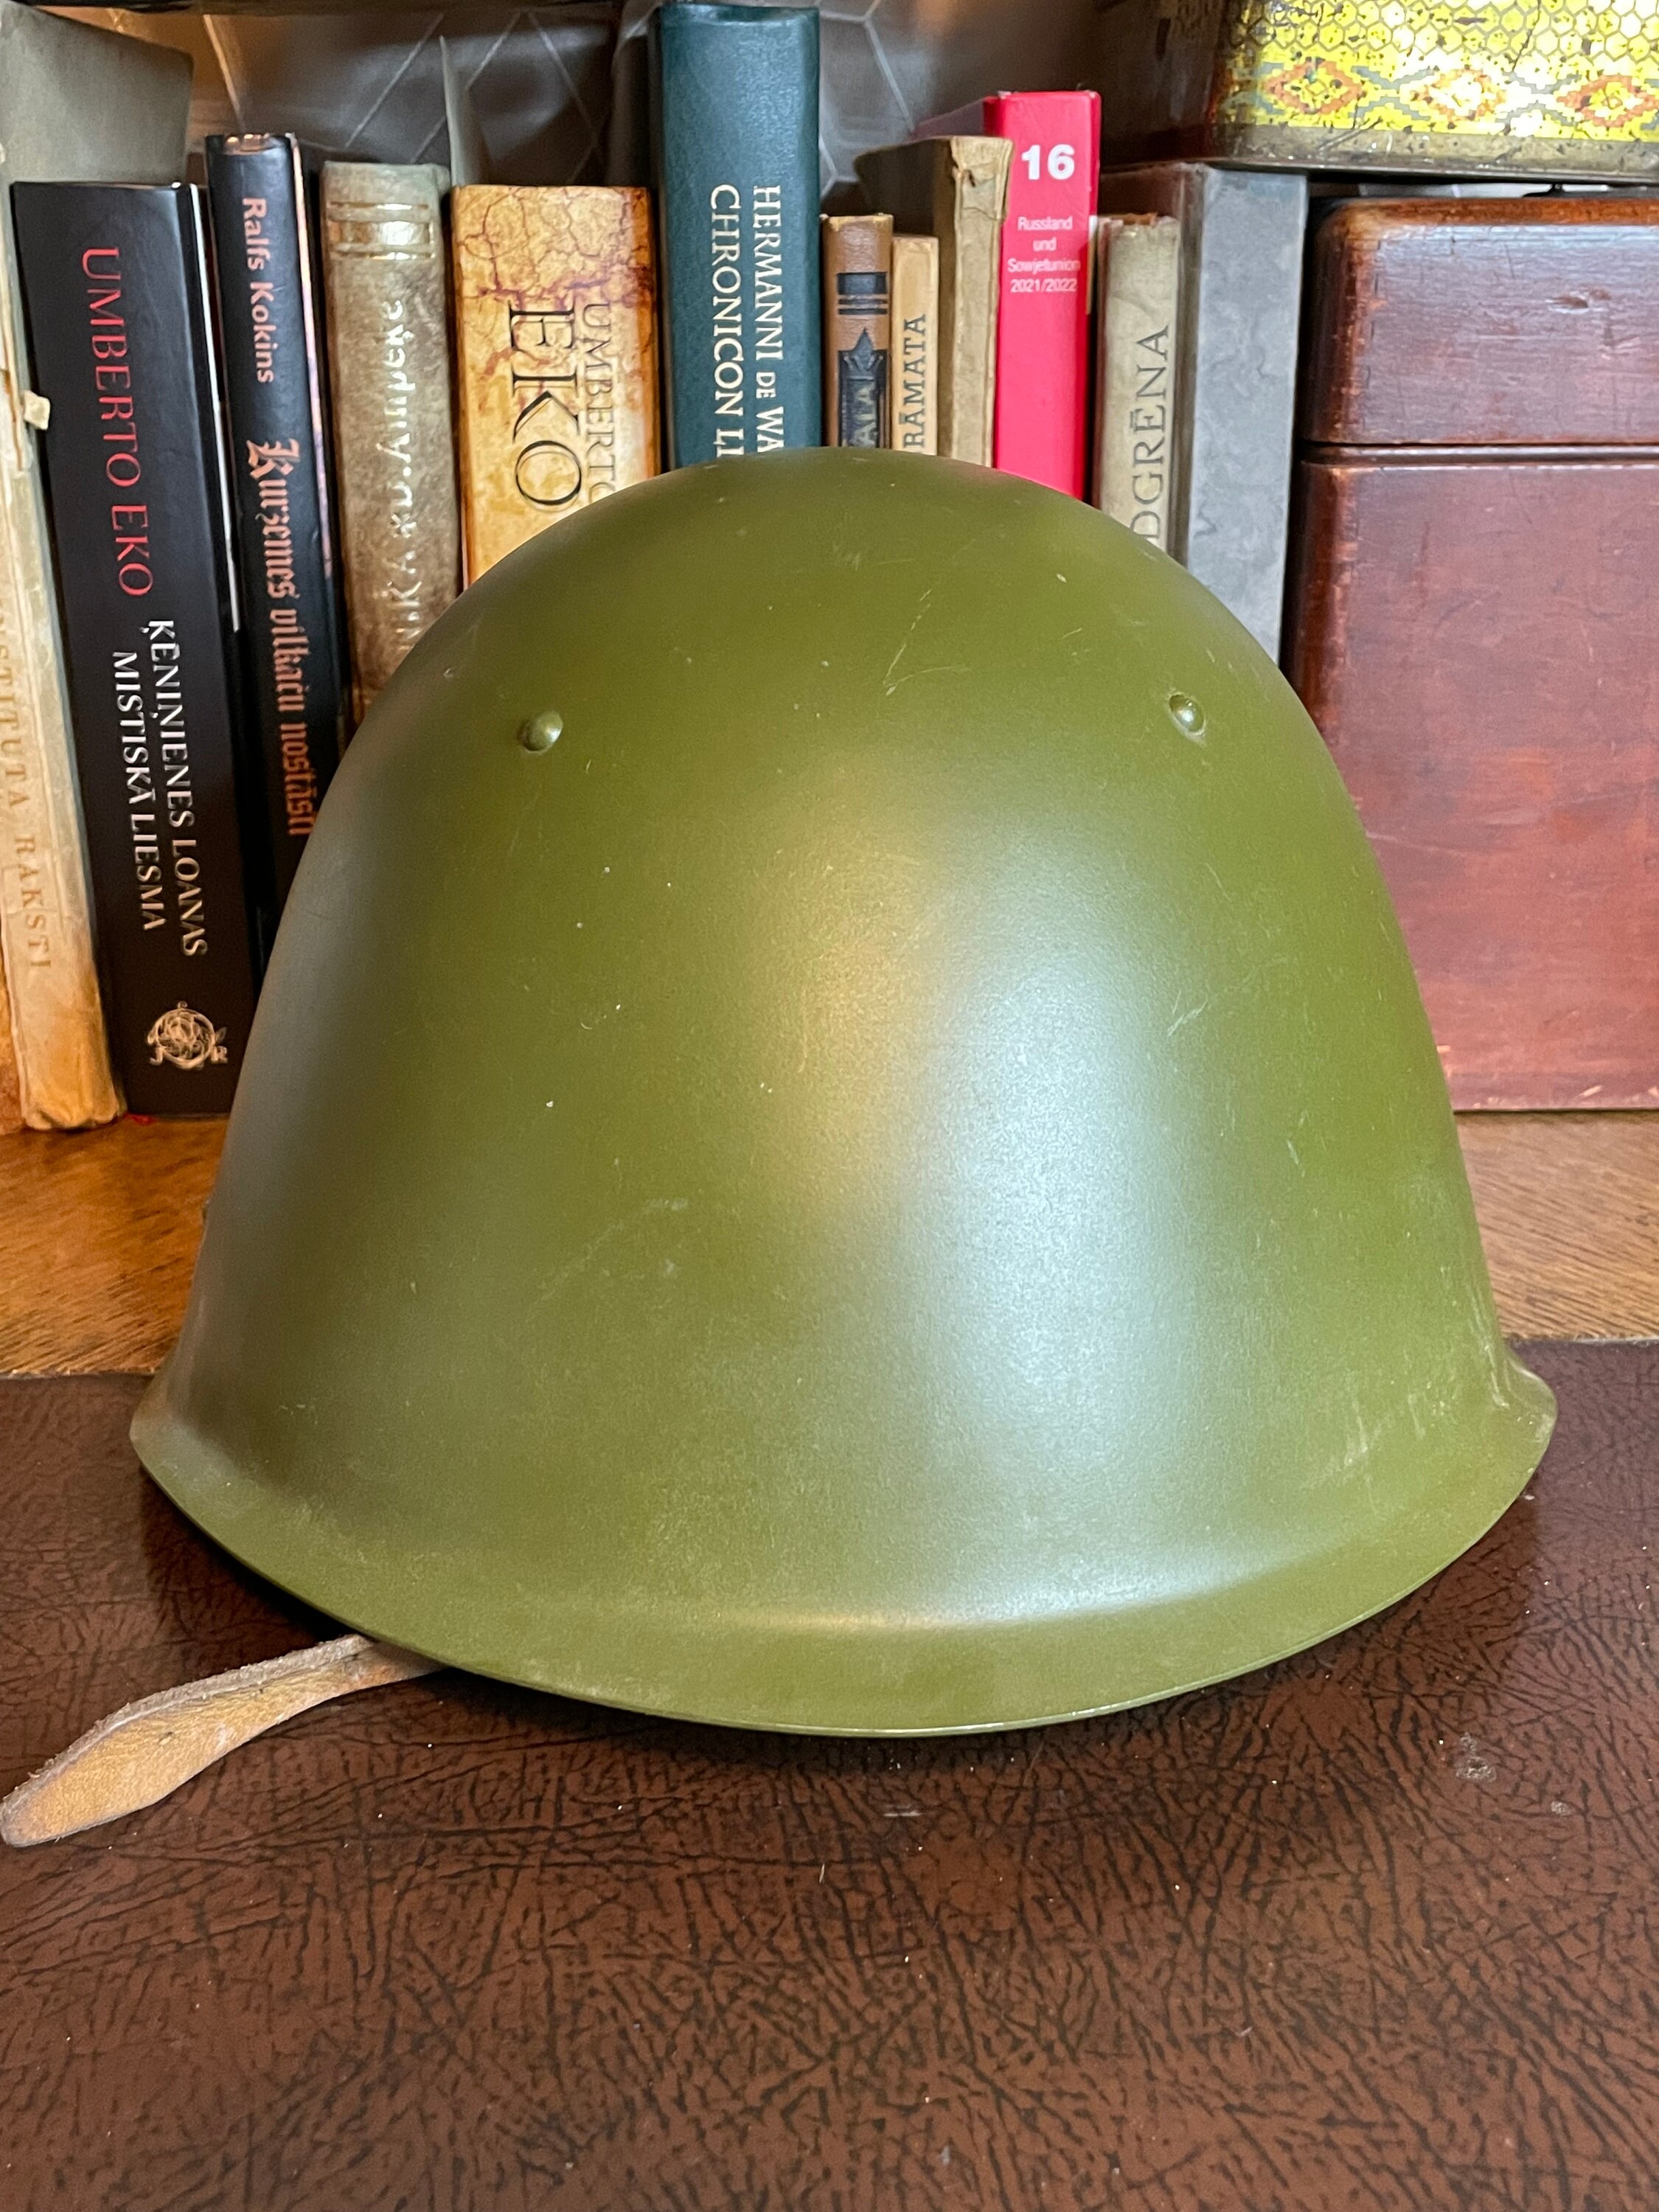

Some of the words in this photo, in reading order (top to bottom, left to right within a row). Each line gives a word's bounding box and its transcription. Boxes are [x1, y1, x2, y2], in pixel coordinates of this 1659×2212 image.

[1021, 144, 1075, 180] 16
[242, 197, 271, 271] Ralfs
[753, 185, 783, 360] HERMANNI
[1007, 257, 1080, 274] Sowjetunion
[1018, 215, 1073, 230] Russland
[1032, 237, 1057, 251] und
[250, 282, 278, 383] Kokins
[710, 184, 745, 417] CHRONICON
[1010, 278, 1078, 293] 2021/2022
[82, 247, 141, 487] UMBERTO
[508, 300, 582, 509] EKO
[756, 372, 776, 399] DE
[899, 314, 927, 448] RĀMATA
[756, 406, 785, 453] WA
[111, 505, 153, 596] EKO
[246, 437, 301, 599] Kurzemes
[112, 652, 156, 804] MISTISKĀ
[139, 620, 195, 827] ĶĒNIŅIENES
[172, 839, 208, 956] LOANAS
[15, 835, 52, 968] RAKSTI
[131, 814, 167, 930] LIESMA
